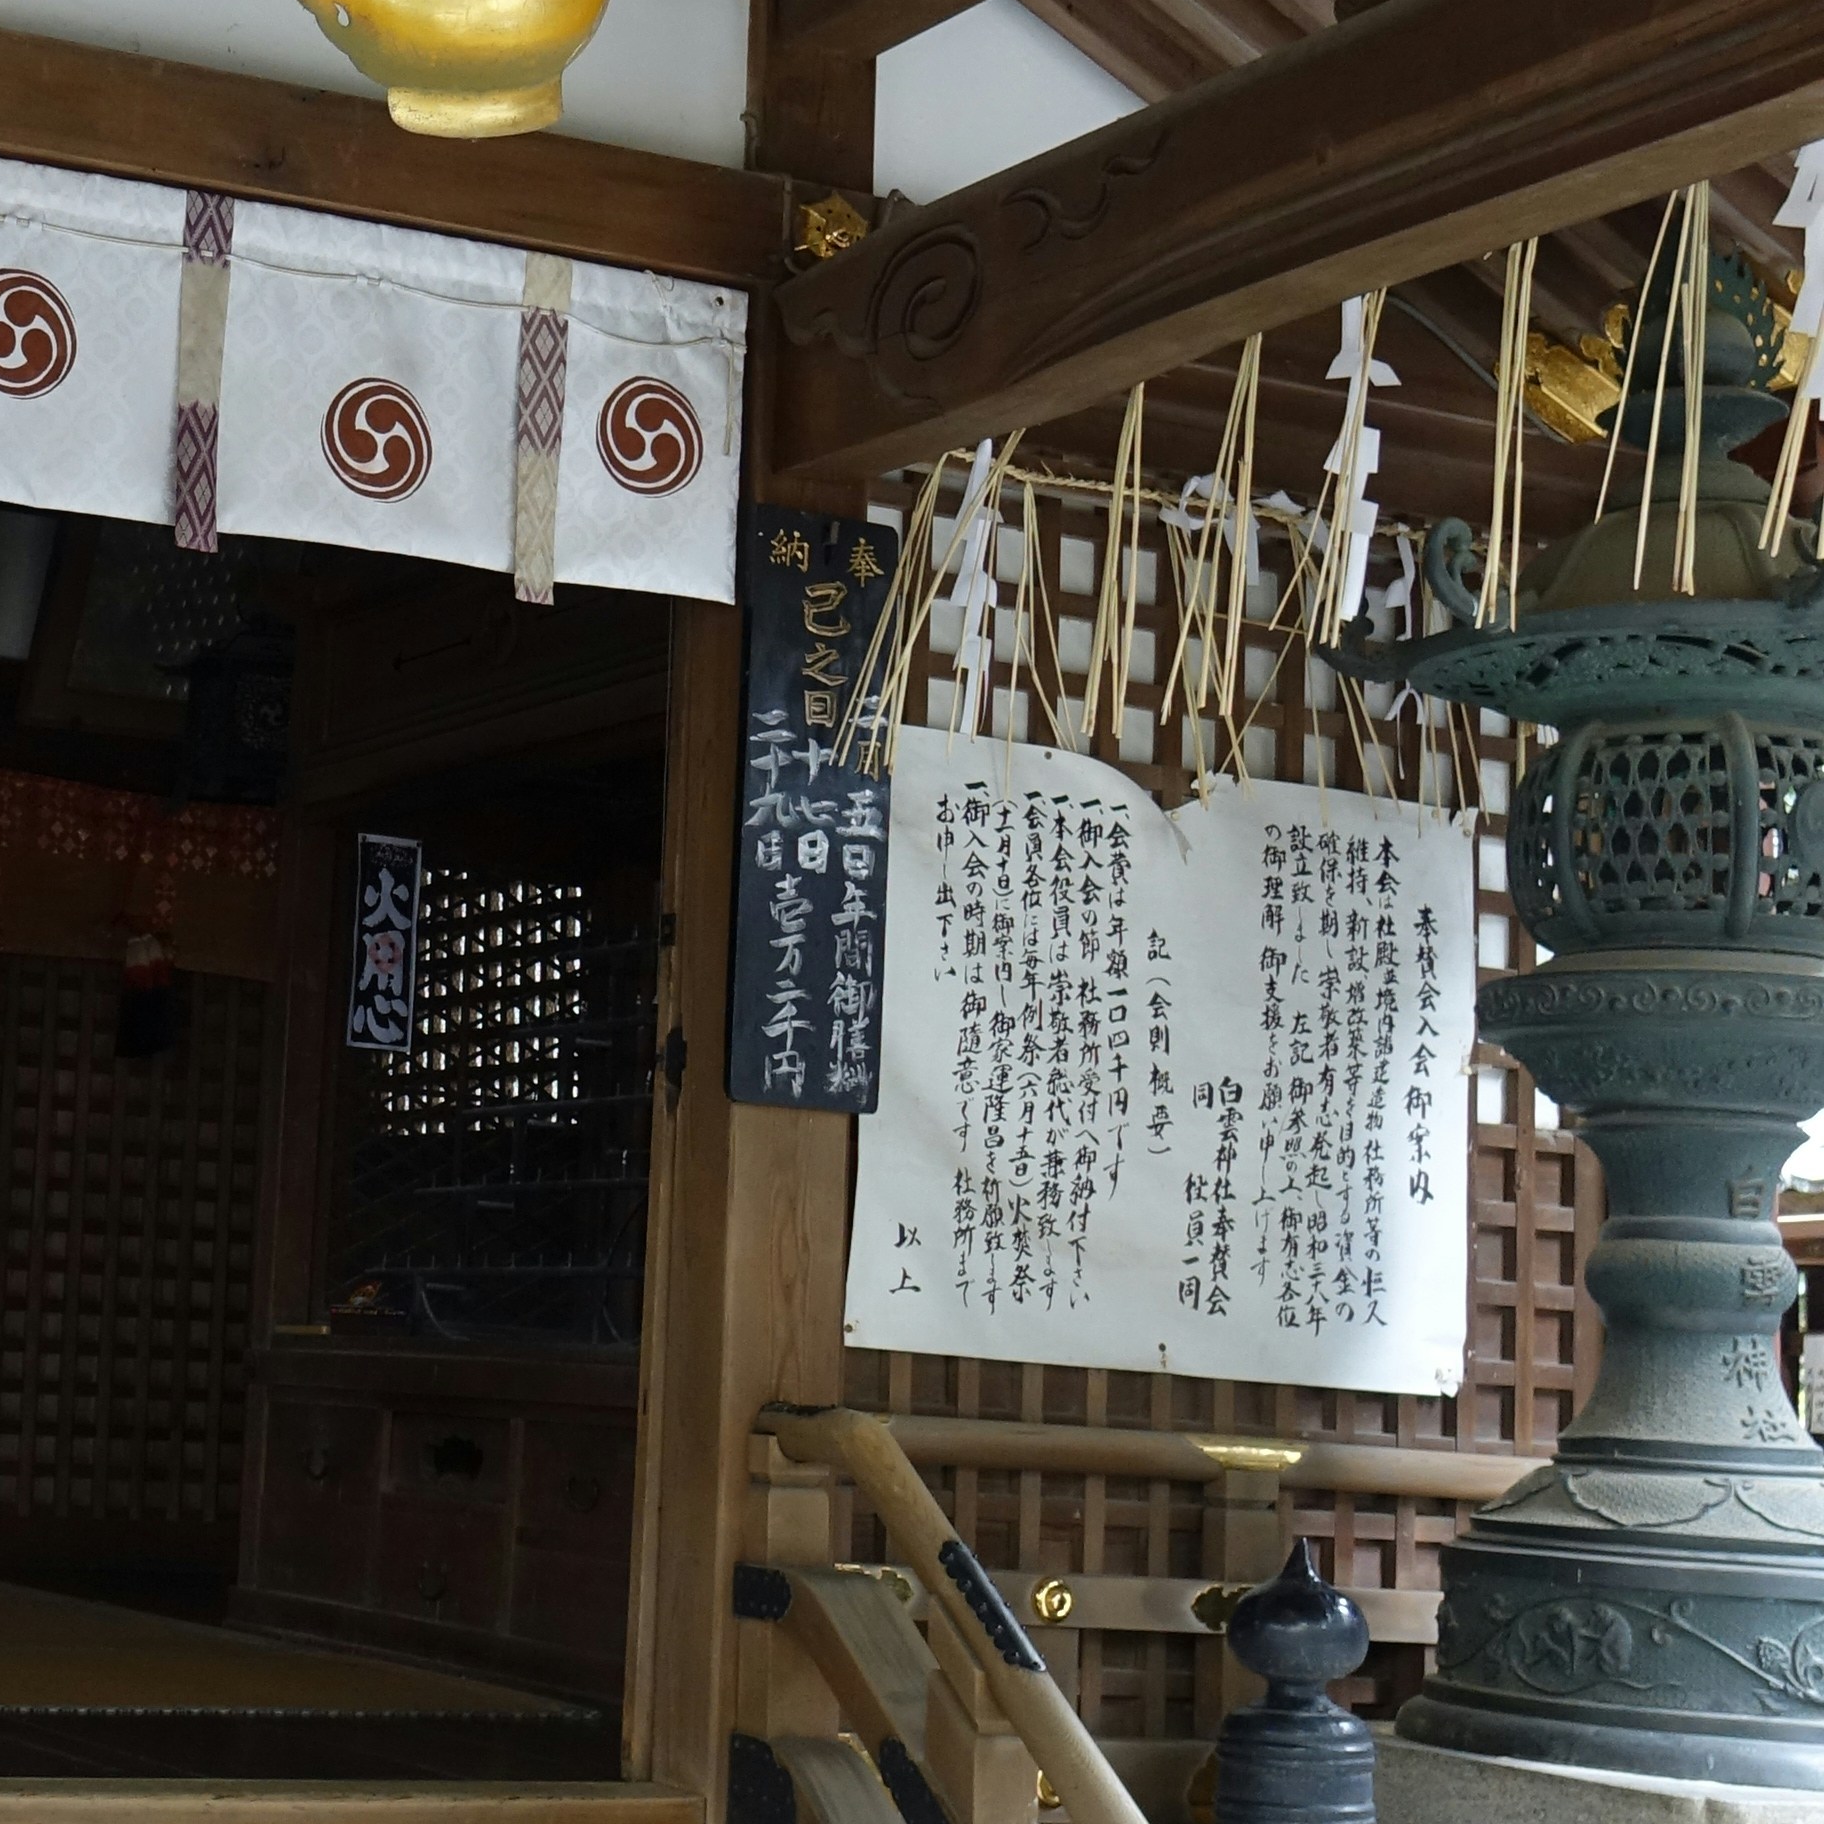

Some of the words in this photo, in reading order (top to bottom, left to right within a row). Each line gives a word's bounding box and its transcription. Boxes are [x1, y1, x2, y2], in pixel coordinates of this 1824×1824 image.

[353, 867, 412, 1044] 火用心
[889, 1222, 922, 1294] 以上
